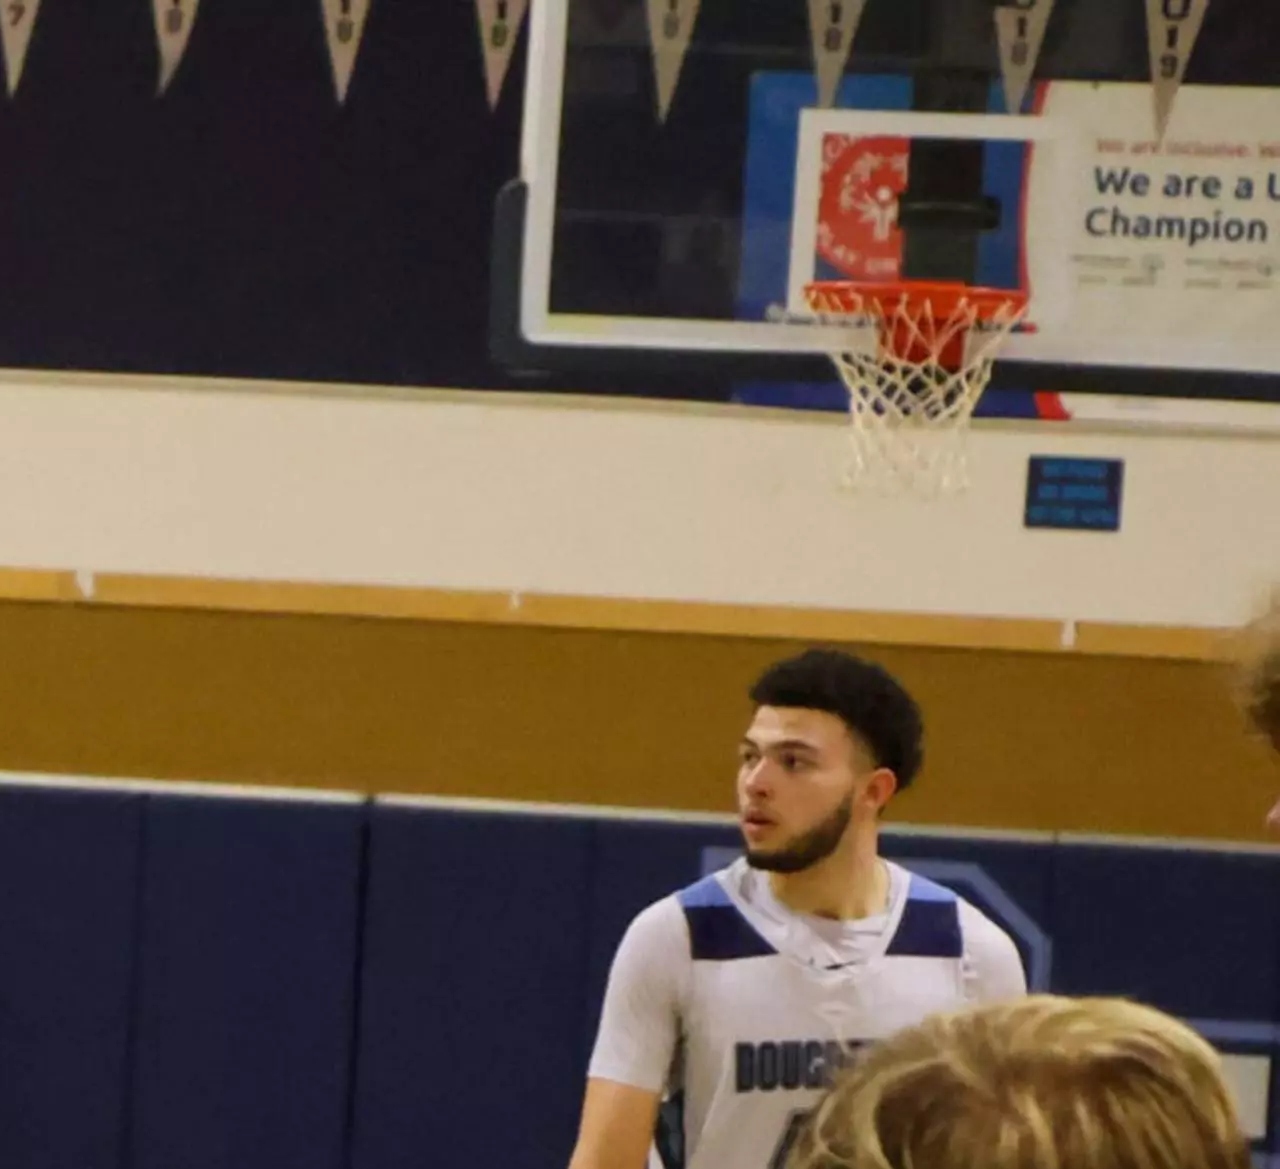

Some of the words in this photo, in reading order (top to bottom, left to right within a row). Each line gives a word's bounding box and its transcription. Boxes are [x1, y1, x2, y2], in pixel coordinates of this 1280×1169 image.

[1095, 166, 1150, 197] We
[1162, 174, 1222, 198] are
[1234, 177, 1253, 200] a
[1085, 205, 1268, 247] Champion
